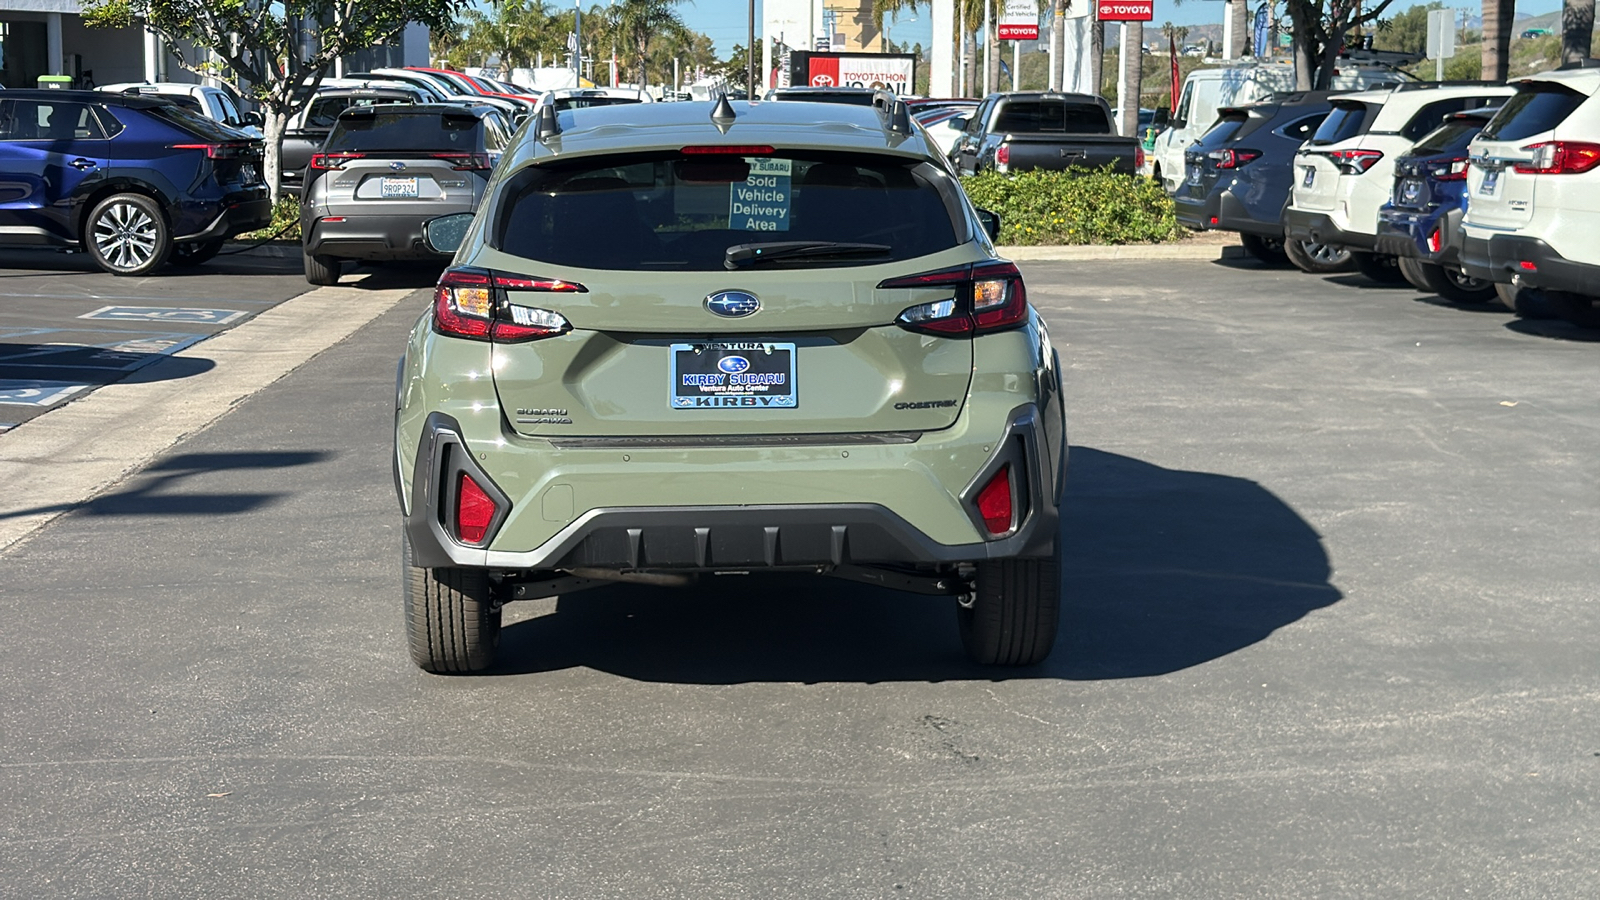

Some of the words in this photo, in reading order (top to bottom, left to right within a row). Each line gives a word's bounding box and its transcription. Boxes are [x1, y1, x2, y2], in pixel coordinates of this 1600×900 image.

[1114, 6, 1150, 14] TOYOTA
[844, 72, 906, 82] TOYOTATHON
[759, 162, 790, 172] SUBARU
[746, 176, 777, 187] Sold
[737, 189, 784, 202] Vehicle
[733, 203, 787, 218] Delivery
[746, 218, 777, 231] Area
[702, 343, 765, 351] VENTURA
[683, 374, 725, 385] KIRBY
[729, 373, 785, 385] SUBARU
[745, 384, 769, 392] Center
[696, 397, 774, 407] KIRBY
[894, 399, 957, 410] CROSSTREK
[516, 408, 568, 416] SUBARU
